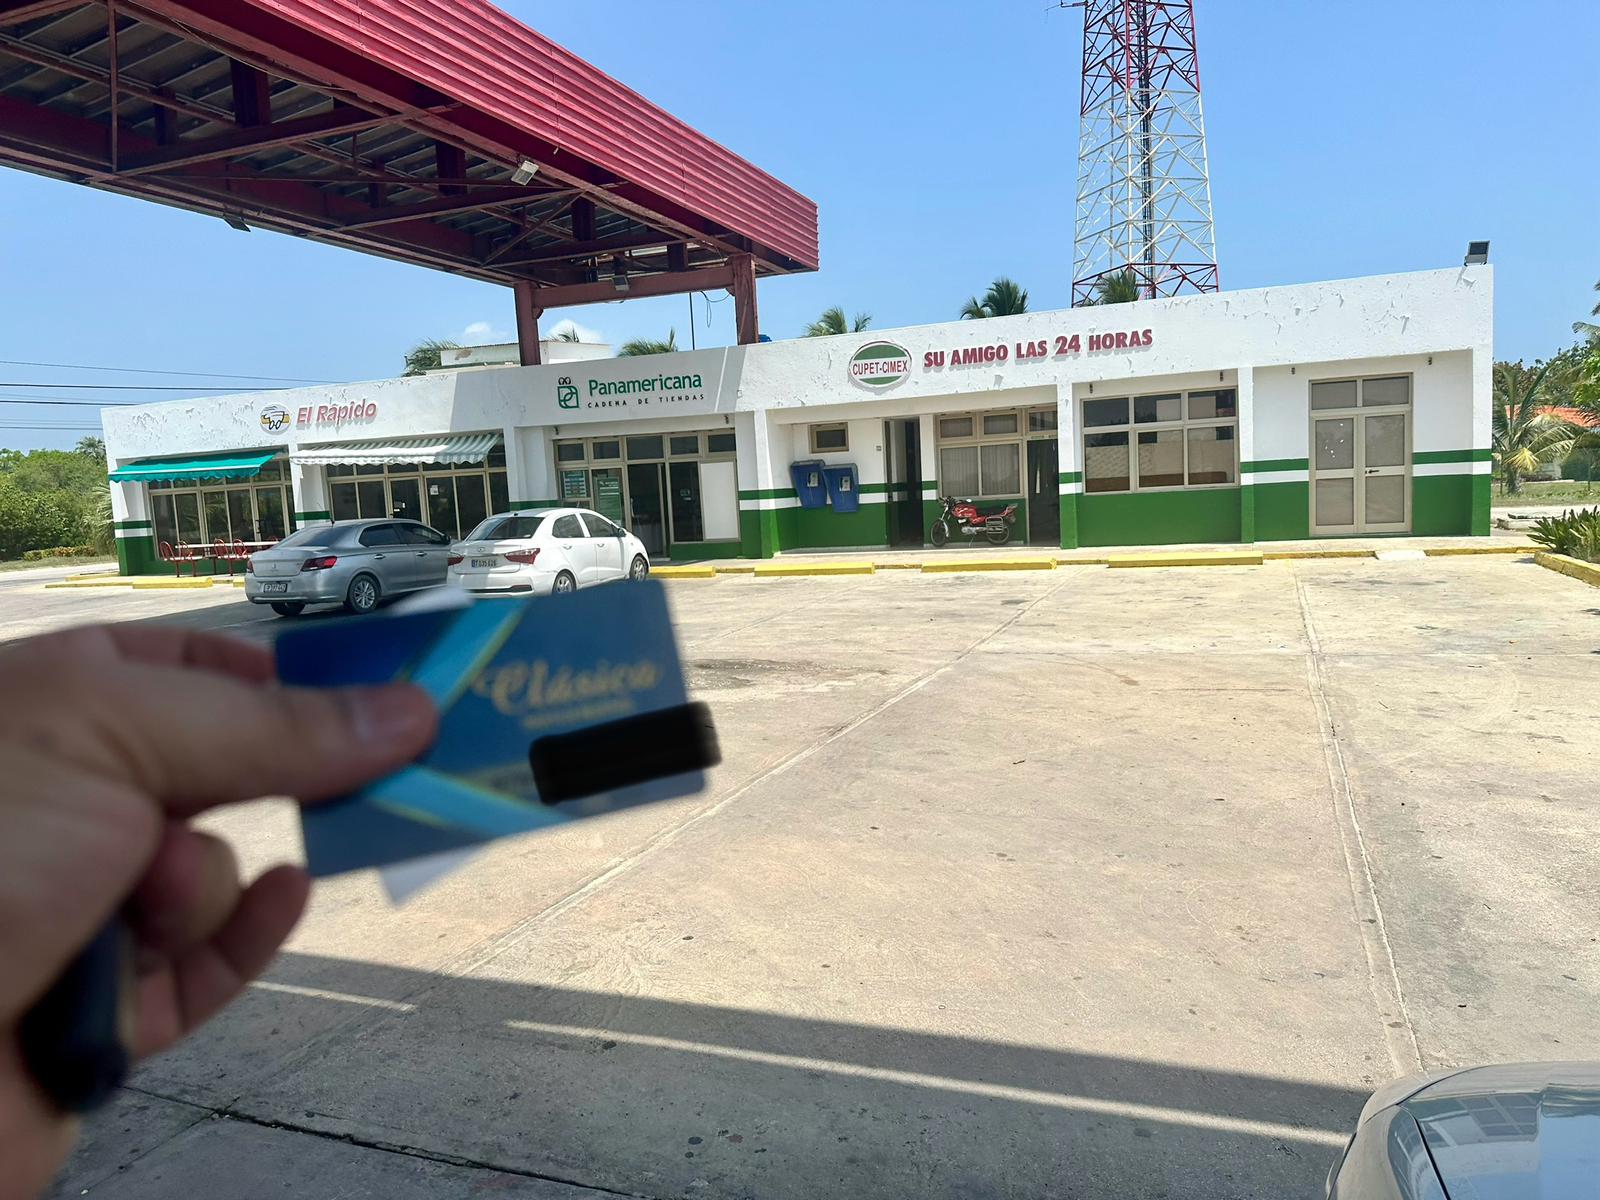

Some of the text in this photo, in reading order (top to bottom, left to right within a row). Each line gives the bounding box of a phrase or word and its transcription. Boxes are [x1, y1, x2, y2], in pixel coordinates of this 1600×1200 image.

[923, 329, 1153, 368] SU AMIGO LAS 24 HORAS
[852, 360, 908, 376] CUPET-CIMEX
[588, 374, 702, 397] Panamericana
[297, 398, 377, 426] El Rápido
[587, 394, 705, 409] CADENA DE TIENDAS
